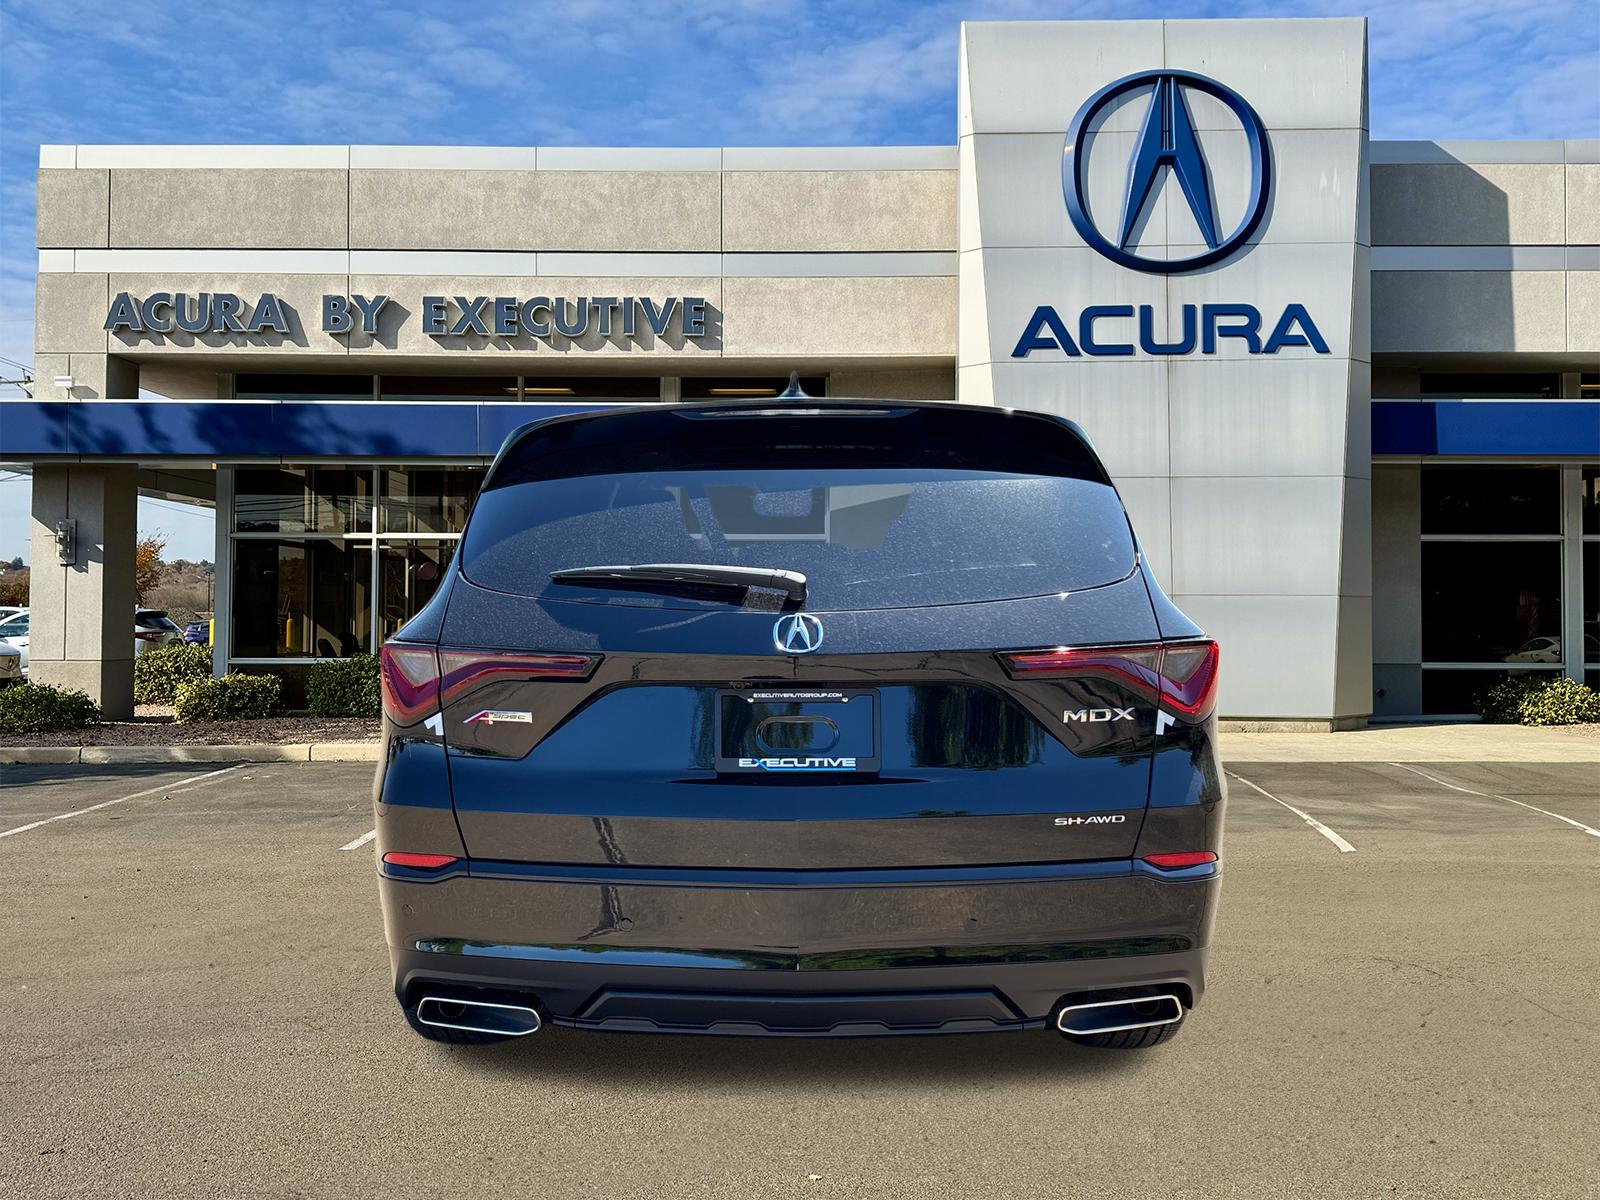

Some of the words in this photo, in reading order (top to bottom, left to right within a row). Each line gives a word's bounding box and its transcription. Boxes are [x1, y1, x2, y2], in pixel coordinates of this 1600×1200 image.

[103, 292, 290, 333] ACURA
[322, 295, 390, 334] BY
[421, 296, 707, 336] EXECUTIVE
[1010, 303, 1332, 357] ACURA
[1063, 707, 1135, 723] MDX
[738, 757, 856, 770] EXECUTIVE
[1054, 814, 1126, 826] SH-AWD
